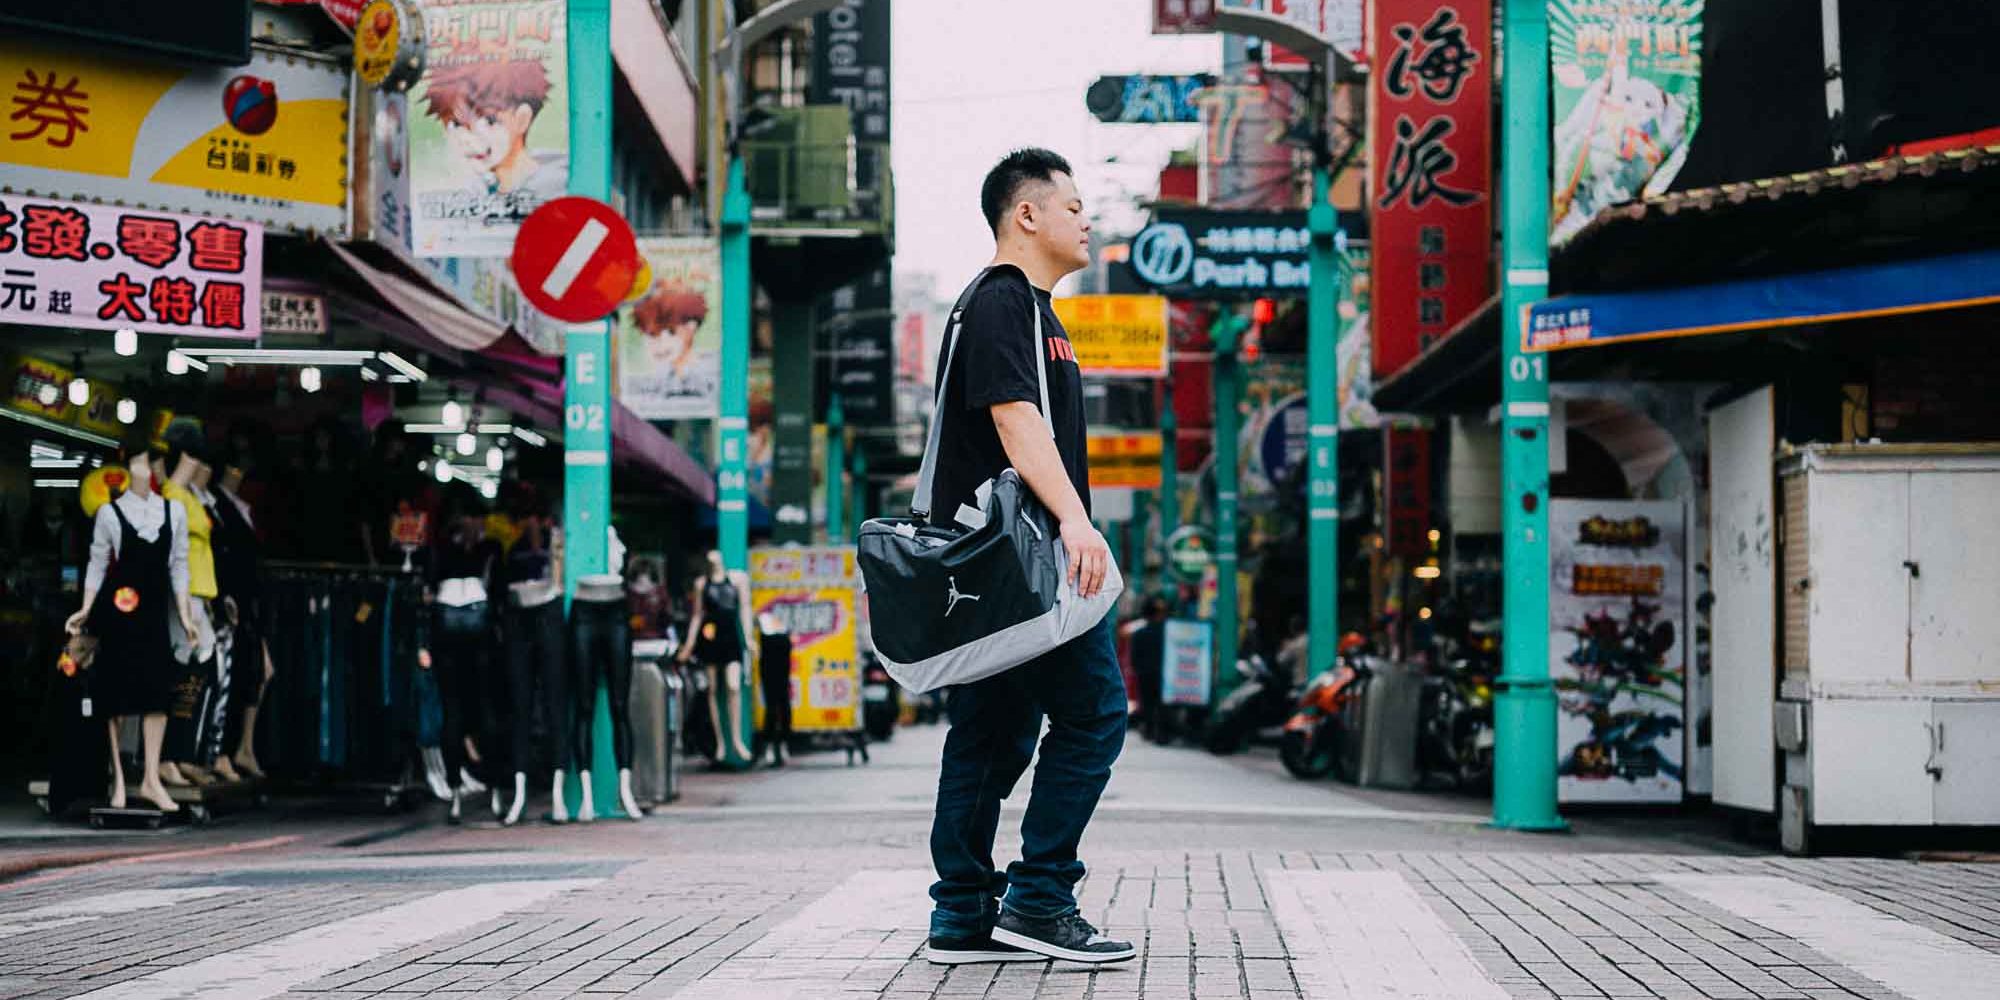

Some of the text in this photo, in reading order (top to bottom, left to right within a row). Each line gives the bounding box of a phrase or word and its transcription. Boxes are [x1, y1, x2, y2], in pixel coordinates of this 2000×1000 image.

[829, 0, 864, 76] otel
[11, 68, 90, 148] 券
[1379, 8, 1483, 208] 海派
[0, 201, 247, 275] 發.零售
[96, 272, 245, 330] 大特價
[576, 352, 596, 384] E
[1510, 355, 1543, 381] 01
[565, 403, 604, 431] 02
